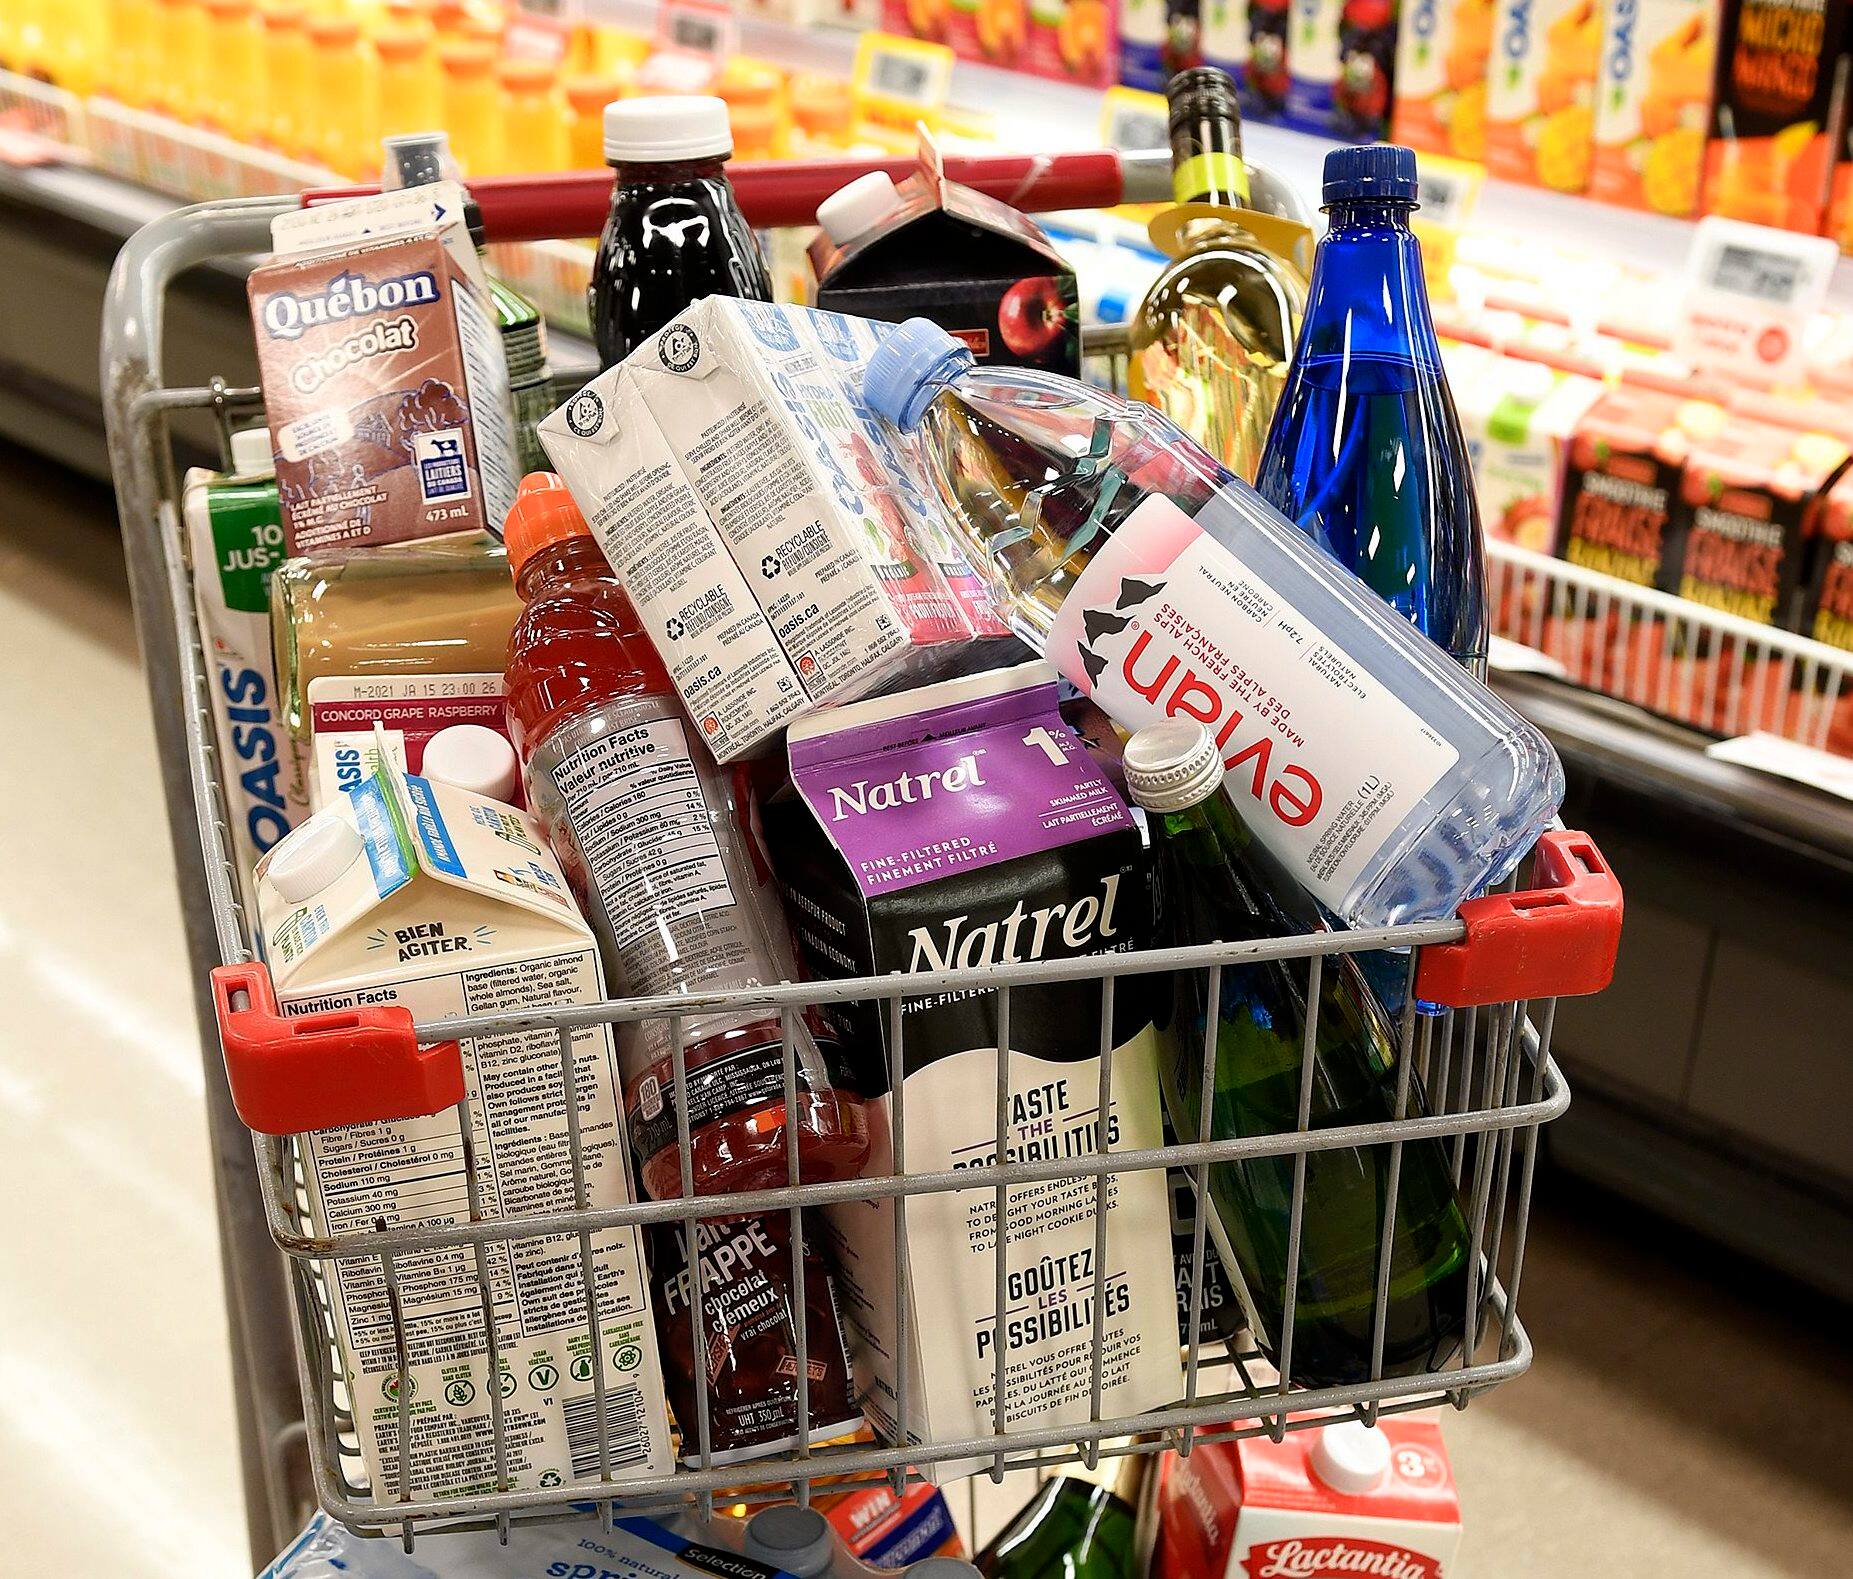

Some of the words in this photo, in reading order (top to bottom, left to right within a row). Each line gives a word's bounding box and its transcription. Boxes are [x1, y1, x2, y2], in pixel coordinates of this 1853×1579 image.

[265, 272, 437, 339] Québon
[293, 318, 417, 392] Chocolat
[426, 510, 448, 520] 473
[449, 506, 469, 518] mL
[776, 519, 824, 559] RECYCLABLE
[1199, 565, 1231, 596] NEUTRAL
[1228, 581, 1238, 590] EN
[679, 584, 725, 622] RECYCLABLE
[1231, 595, 1262, 623] CARBON
[1238, 580, 1273, 612] CARBONE
[1239, 591, 1268, 617] NEUTRE
[779, 603, 820, 638] oasis.ca
[1153, 613, 1183, 639] ALPS
[1161, 603, 1230, 666] FRANÇAISES
[1278, 621, 1304, 645] 7.2pH
[1183, 639, 1229, 681] FRENCH
[1308, 658, 1341, 688] NATURAL
[1319, 646, 1356, 680] NATURELS
[354, 685, 393, 698] M-2021
[402, 685, 415, 696] JA
[424, 684, 435, 696] 15
[442, 683, 475, 695] 23:00
[482, 682, 496, 694] 26
[684, 666, 722, 699] oasis.ca
[1229, 680, 1251, 702] THE
[1230, 665, 1266, 697] ALPES
[321, 709, 381, 721] CONCORD
[384, 708, 423, 719] GRAPE
[429, 705, 497, 718] RASPBERRY
[783, 699, 805, 715] CALGARY
[1253, 702, 1270, 718] BY
[1267, 697, 1291, 719] DES
[1122, 629, 1323, 827] evian
[1271, 716, 1304, 748] MADE
[223, 666, 293, 853] OASIS
[554, 745, 607, 782] Nutrition
[608, 728, 649, 749] Facts
[1022, 727, 1069, 766] 1
[1049, 729, 1066, 739] %
[335, 749, 362, 793] ASIS
[560, 765, 596, 794] Valeur
[600, 743, 655, 771] nutritive
[828, 754, 985, 822] Natrel
[1050, 791, 1087, 807] SKIMMED
[1087, 787, 1108, 798] MILK
[1074, 778, 1103, 791] PARTLY
[1357, 775, 1380, 799] (1L)
[577, 813, 600, 831] Calories
[605, 797, 632, 813] Calories
[1042, 819, 1061, 829] LAIT
[1060, 803, 1118, 825] PARTIELLEMENT
[1092, 811, 1123, 827] ÉCRÉMÉ
[586, 838, 607, 854] Sodium
[610, 822, 635, 836] Sodium
[636, 814, 649, 824] 300
[650, 811, 661, 821] mg
[861, 836, 971, 873] FINE-FILTERED
[866, 858, 943, 885] FINEMENT
[949, 841, 998, 865] FILTRÉ
[395, 922, 445, 944] BIEN
[908, 873, 1121, 974] Natrel
[398, 936, 473, 962] AGITER.
[466, 967, 517, 982] Ingredients:
[520, 960, 552, 973] Organic
[554, 955, 583, 966] almond
[468, 982, 488, 992] base
[490, 977, 520, 989] (filtered
[522, 972, 546, 983] water,
[549, 966, 578, 978] organic
[287, 995, 353, 1016] Nutrition
[356, 988, 398, 1009] Facts
[469, 991, 493, 1002] whole
[495, 985, 535, 998] almonds),
[537, 981, 554, 990] Sea
[556, 978, 572, 987] salt,
[471, 1002, 498, 1012] Gellan
[500, 998, 520, 1008] gum,
[522, 991, 551, 1002] Natural
[553, 986, 582, 998] flavour,
[901, 987, 1000, 1015] FINE-FILTE
[483, 1072, 501, 1082] May
[503, 1068, 535, 1080] contain
[537, 1062, 558, 1073] other
[579, 1053, 600, 1065] nuts.
[495, 1137, 542, 1150] Ingrédients
[1018, 1118, 1053, 1141] THE
[319, 1153, 350, 1167] Protein
[358, 1147, 400, 1160] Protéines
[410, 1145, 416, 1153] g
[321, 1164, 372, 1179] Cholesterol
[380, 1155, 430, 1170] Cholestérol
[433, 1152, 438, 1160] 0
[440, 1151, 454, 1159] mg
[496, 1146, 536, 1160] biologique
[324, 1179, 358, 1192] Sodium
[360, 1176, 375, 1185] 110
[377, 1174, 391, 1184] mg
[1010, 1186, 1045, 1202] OFFERS
[327, 1194, 370, 1206] Potassium
[384, 1189, 399, 1198] mg
[329, 1207, 363, 1218] Calcium
[365, 1203, 381, 1212] 300
[383, 1202, 396, 1211] mg
[1031, 1195, 1058, 1210] YOUR
[1061, 1185, 1089, 1200] TASTE
[1036, 1201, 1082, 1222] MORNING
[1015, 1226, 1044, 1241] NIGHT
[1048, 1212, 1084, 1230] COOKIE
[1008, 1248, 1093, 1301] GOÛTEZ
[704, 1269, 769, 1316] chocolat
[1038, 1289, 1068, 1309] LES
[712, 1286, 780, 1333] crémeux
[741, 1328, 757, 1341] vrai
[758, 1309, 787, 1333] chocolat
[1030, 1351, 1055, 1367] VOUS
[1058, 1342, 1086, 1358] OFFRE
[1056, 1357, 1081, 1372] POUR
[1123, 1334, 1141, 1346] VOS
[1014, 1400, 1025, 1408] LA
[1029, 1384, 1071, 1405] JOURNÉE
[1074, 1378, 1085, 1389] AU
[1112, 1362, 1130, 1375] LAIT
[1023, 1384, 1036, 1394] DU
[1040, 1372, 1067, 1390] LATTÉ
[1070, 1366, 1087, 1378] QUI
[636, 1391, 645, 1419] 12104
[739, 1410, 754, 1427] UHT
[757, 1408, 772, 1422] 350
[1007, 1404, 1048, 1423] BISCUITS
[1050, 1400, 1062, 1408] DE
[1065, 1393, 1079, 1404] FIN
[639, 1426, 651, 1454] 26027
[577, 1538, 617, 1561] 100%
[618, 1557, 679, 1579] natural
[684, 1547, 767, 1579] Selection
[1260, 1540, 1425, 1579] Lactantia
